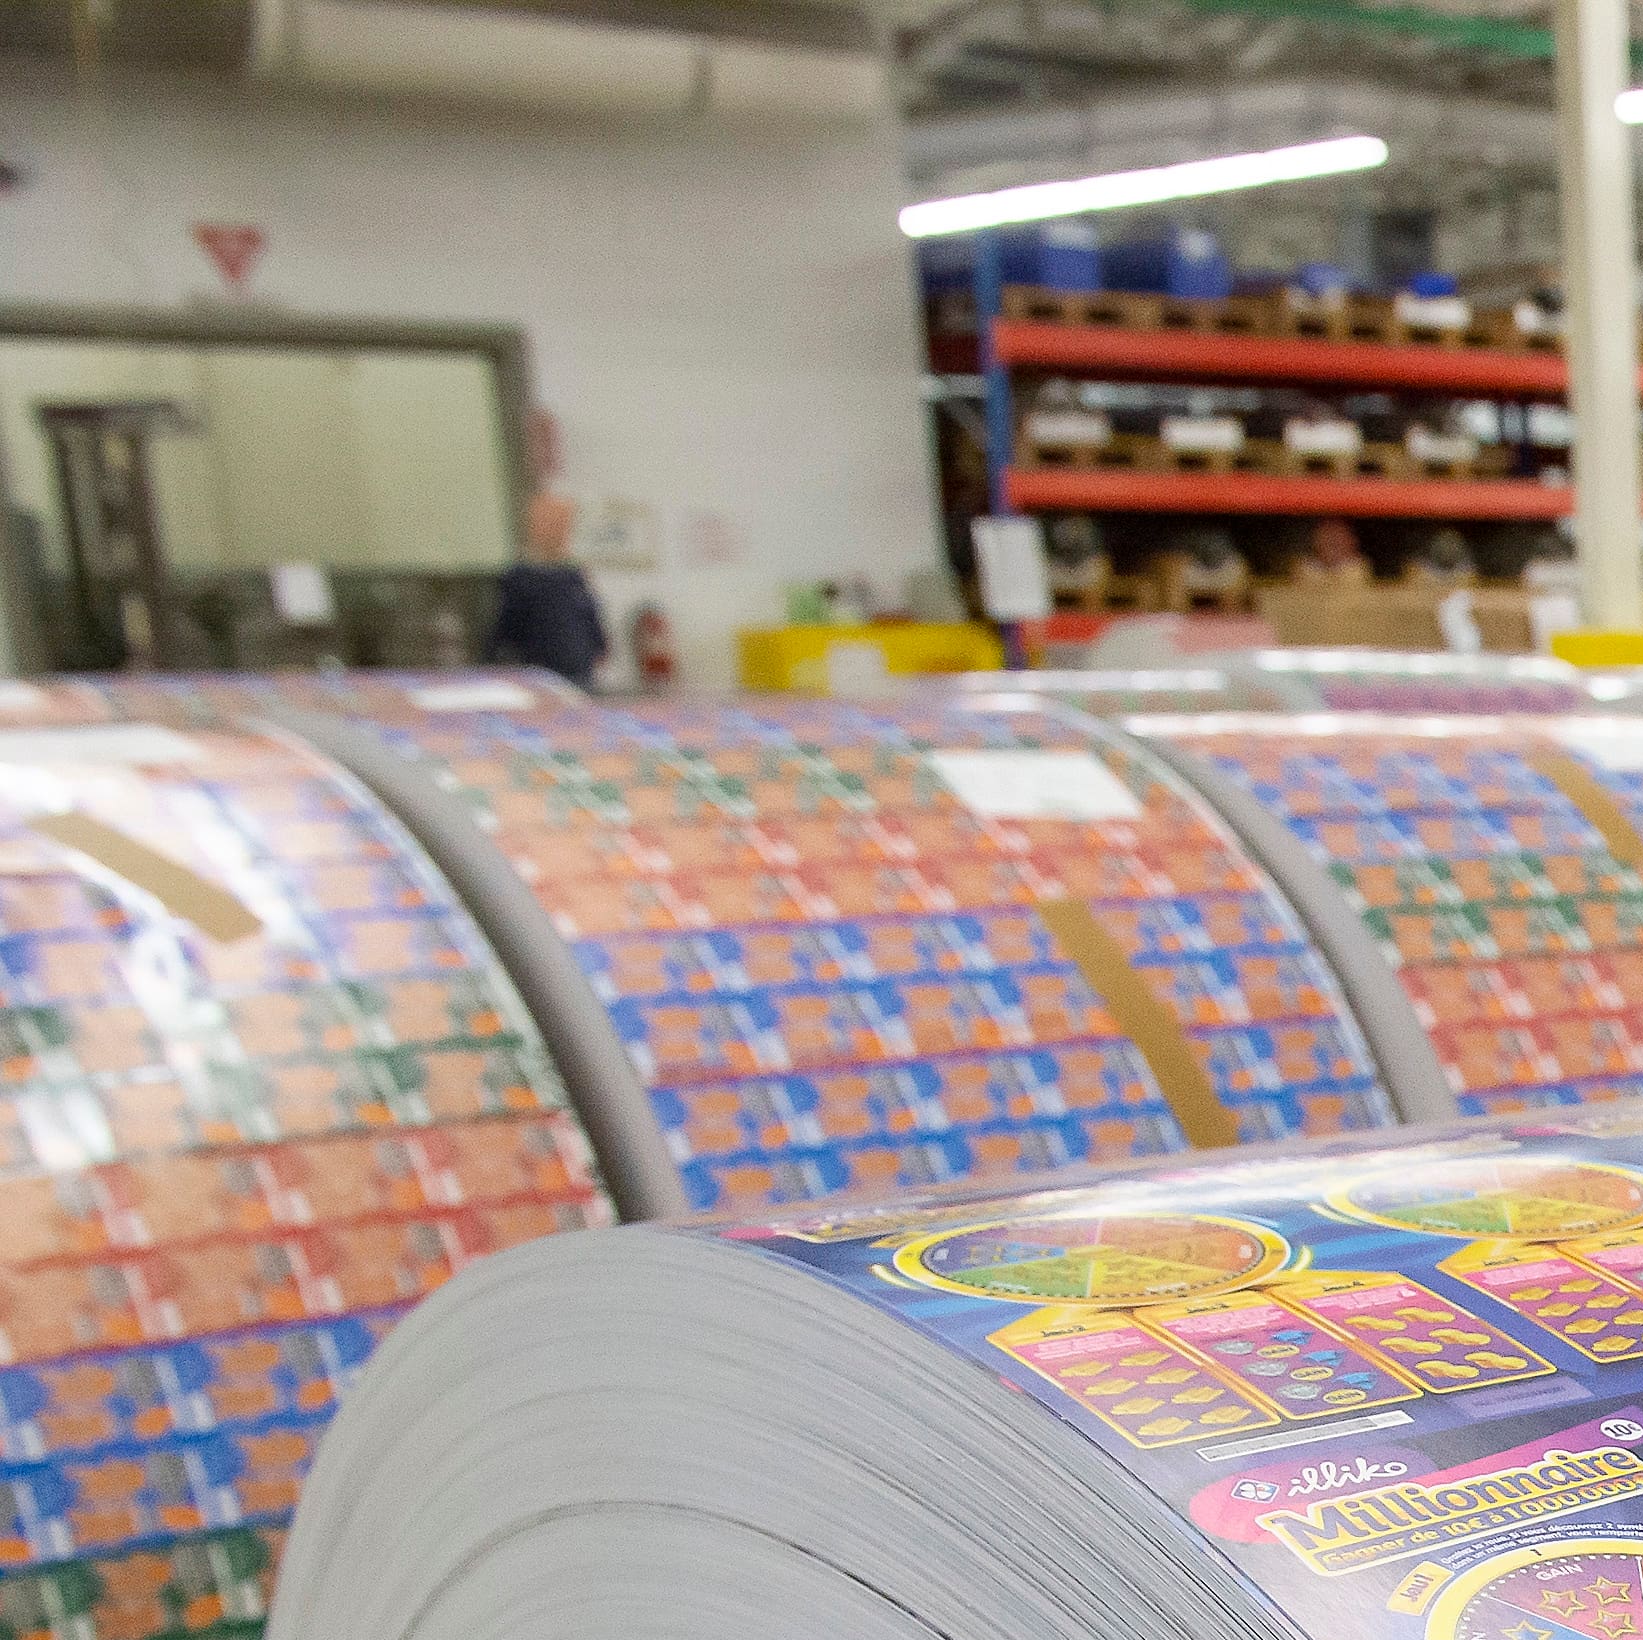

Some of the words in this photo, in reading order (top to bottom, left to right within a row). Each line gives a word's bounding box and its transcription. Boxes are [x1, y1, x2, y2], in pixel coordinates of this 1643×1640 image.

[1607, 1422, 1641, 1438] 10€
[1288, 1457, 1407, 1496] illiko
[1270, 1453, 1636, 1549] Millionnaire
[1323, 1537, 1405, 1564] Gagner
[1410, 1527, 1436, 1544] de
[1441, 1519, 1487, 1535] 10€
[1490, 1512, 1502, 1526] à
[1535, 1564, 1583, 1581] GAIN
